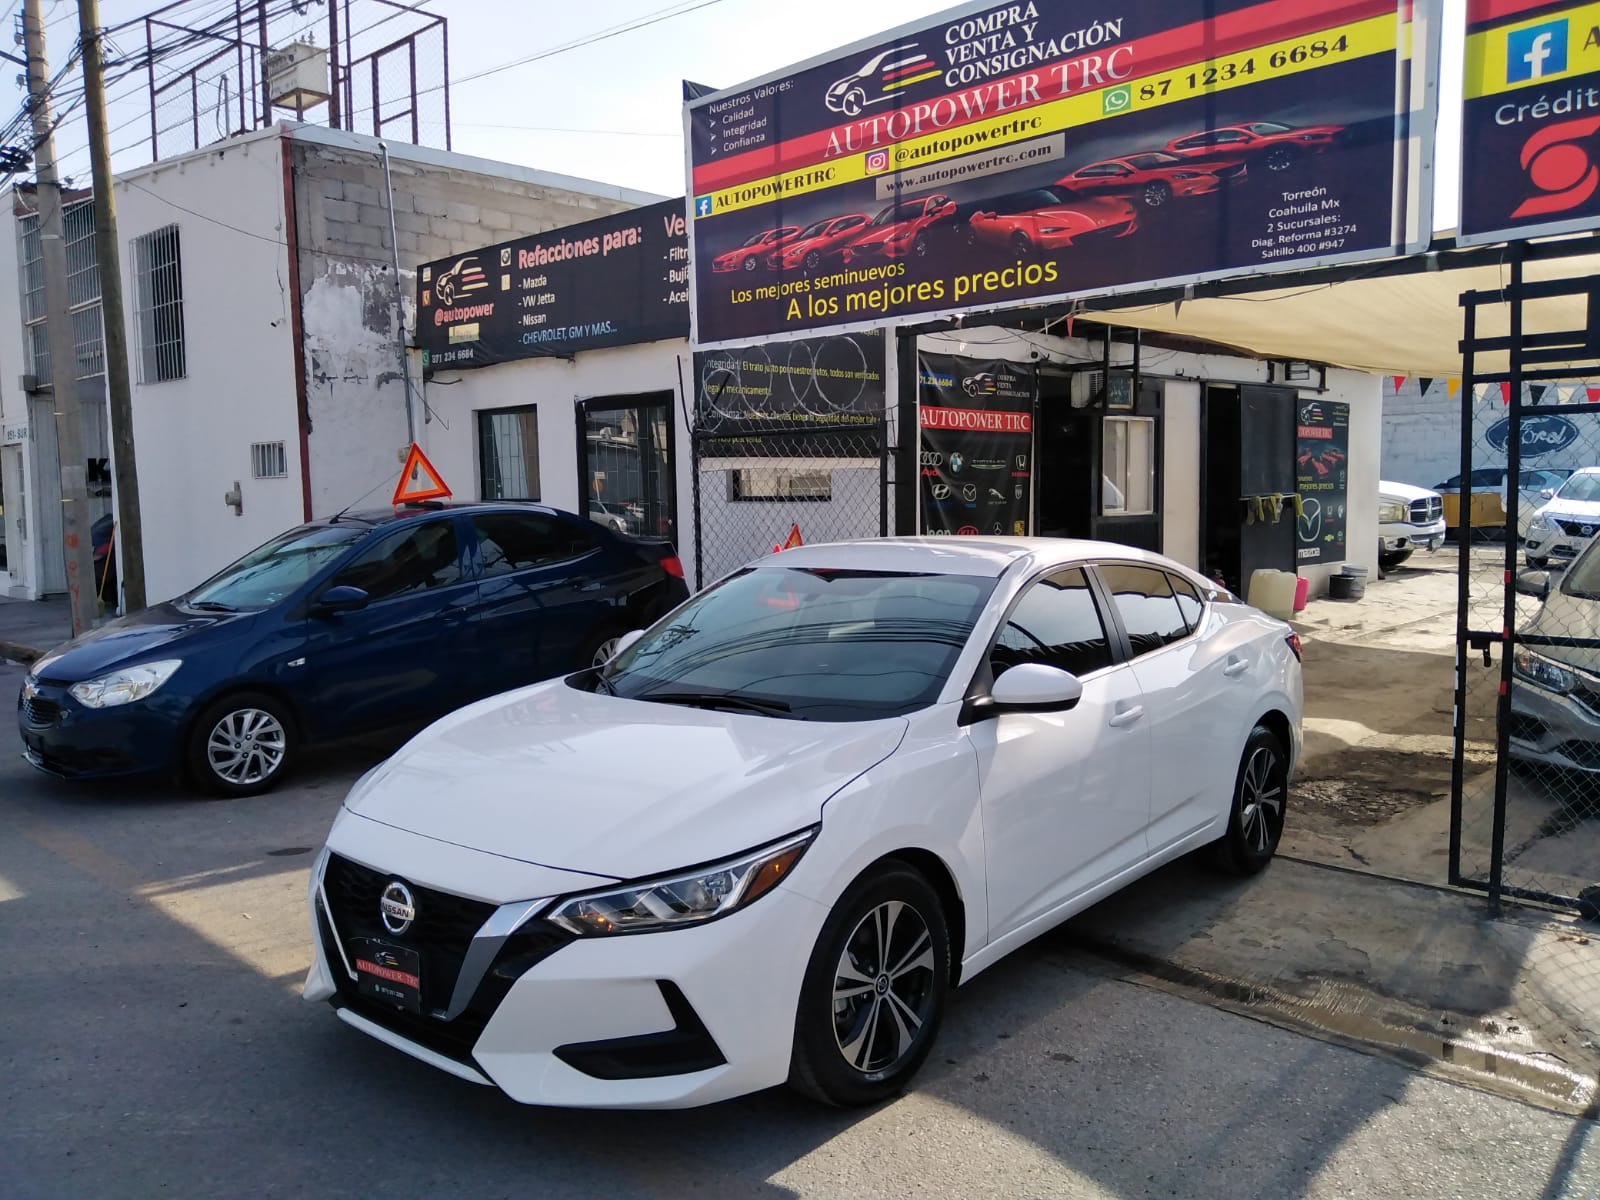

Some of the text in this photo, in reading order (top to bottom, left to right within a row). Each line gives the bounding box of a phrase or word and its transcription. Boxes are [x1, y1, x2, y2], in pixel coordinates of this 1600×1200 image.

[945, 1, 1039, 45] COMPRA
[945, 21, 1039, 65] VENTA Y
[945, 18, 1123, 87] CONSIGNACIÓN
[1139, 35, 1348, 101] 87 1234 6684
[709, 79, 795, 114] Nuestros Valores:
[824, 46, 1134, 157] AUTOPOWER TRC
[722, 107, 754, 124] Calidad
[722, 117, 767, 138] Integridad
[895, 116, 1042, 162] @autopowertrc
[722, 133, 765, 152] Confianza
[886, 144, 1052, 192] www.autopowertrc.com
[715, 167, 836, 209] AUTOPOWERTRC
[1281, 186, 1327, 202] Torreón
[1268, 199, 1340, 218] Coahuila Mx
[1267, 214, 1341, 233] 2 Sucursales:
[518, 226, 642, 270] Refacciones para:
[1251, 224, 1357, 249] Diag. Reforma #3274
[1261, 239, 1345, 259] Saltillo 400 #947
[522, 274, 547, 290] Mazda
[731, 261, 905, 304] Los mejores seminuevos
[787, 260, 1059, 321] A los mejores precios
[522, 292, 556, 308] VW Jetta
[434, 303, 494, 326] @autopower
[522, 313, 547, 326] Nissan
[522, 327, 567, 345] CHEVROLET,
[568, 325, 583, 339] GM
[584, 324, 591, 337] Y
[920, 409, 1030, 430] AUTOPOWER TRC
[383, 902, 409, 918] NISSAN
